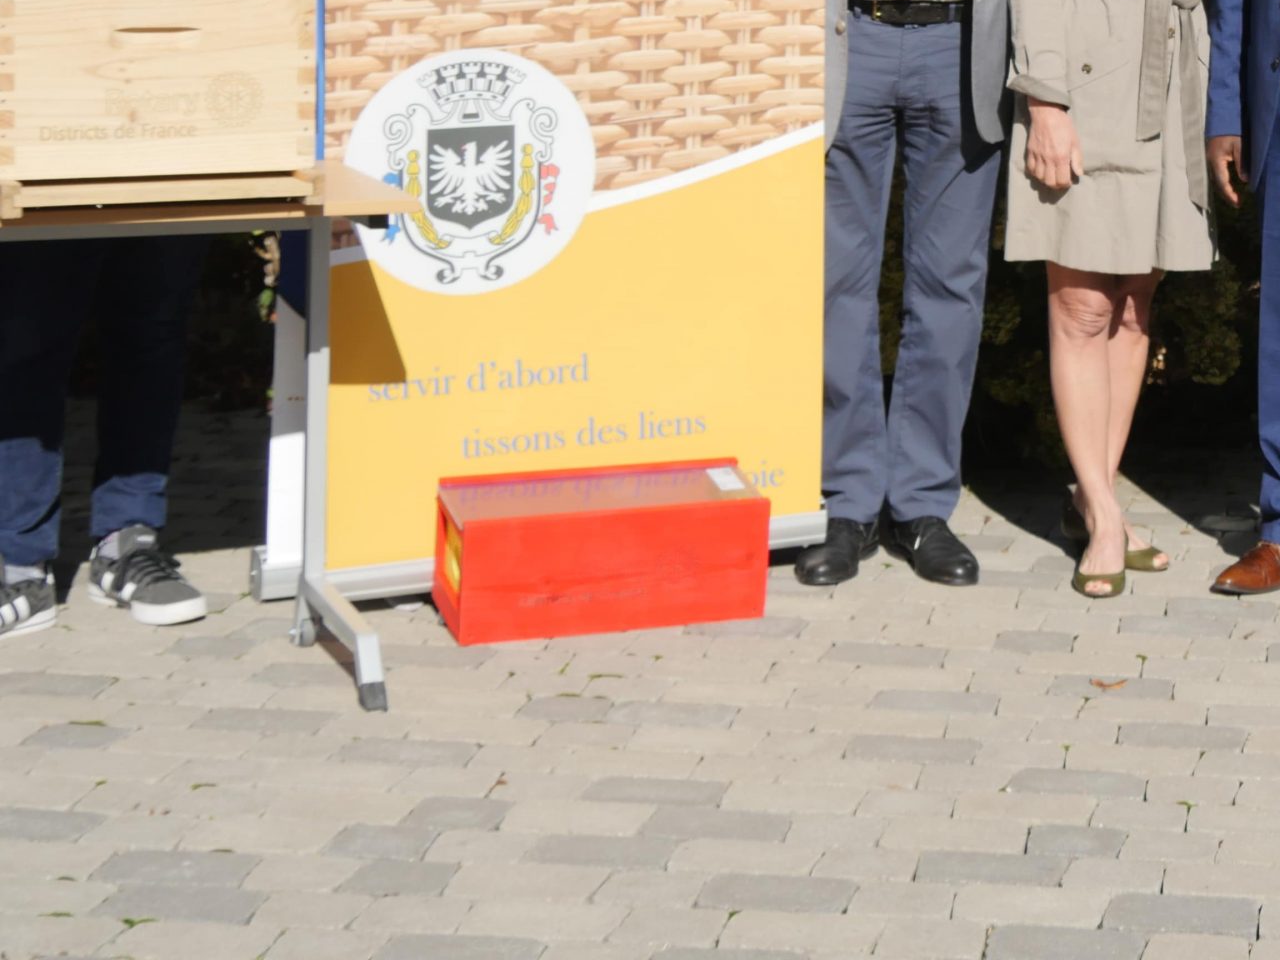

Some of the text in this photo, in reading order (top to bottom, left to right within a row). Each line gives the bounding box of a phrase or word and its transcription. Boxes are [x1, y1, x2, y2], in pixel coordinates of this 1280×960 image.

[39, 122, 198, 142] Districts de France
[367, 353, 590, 403] servir d'abord
[462, 411, 707, 460] tissons des liens
